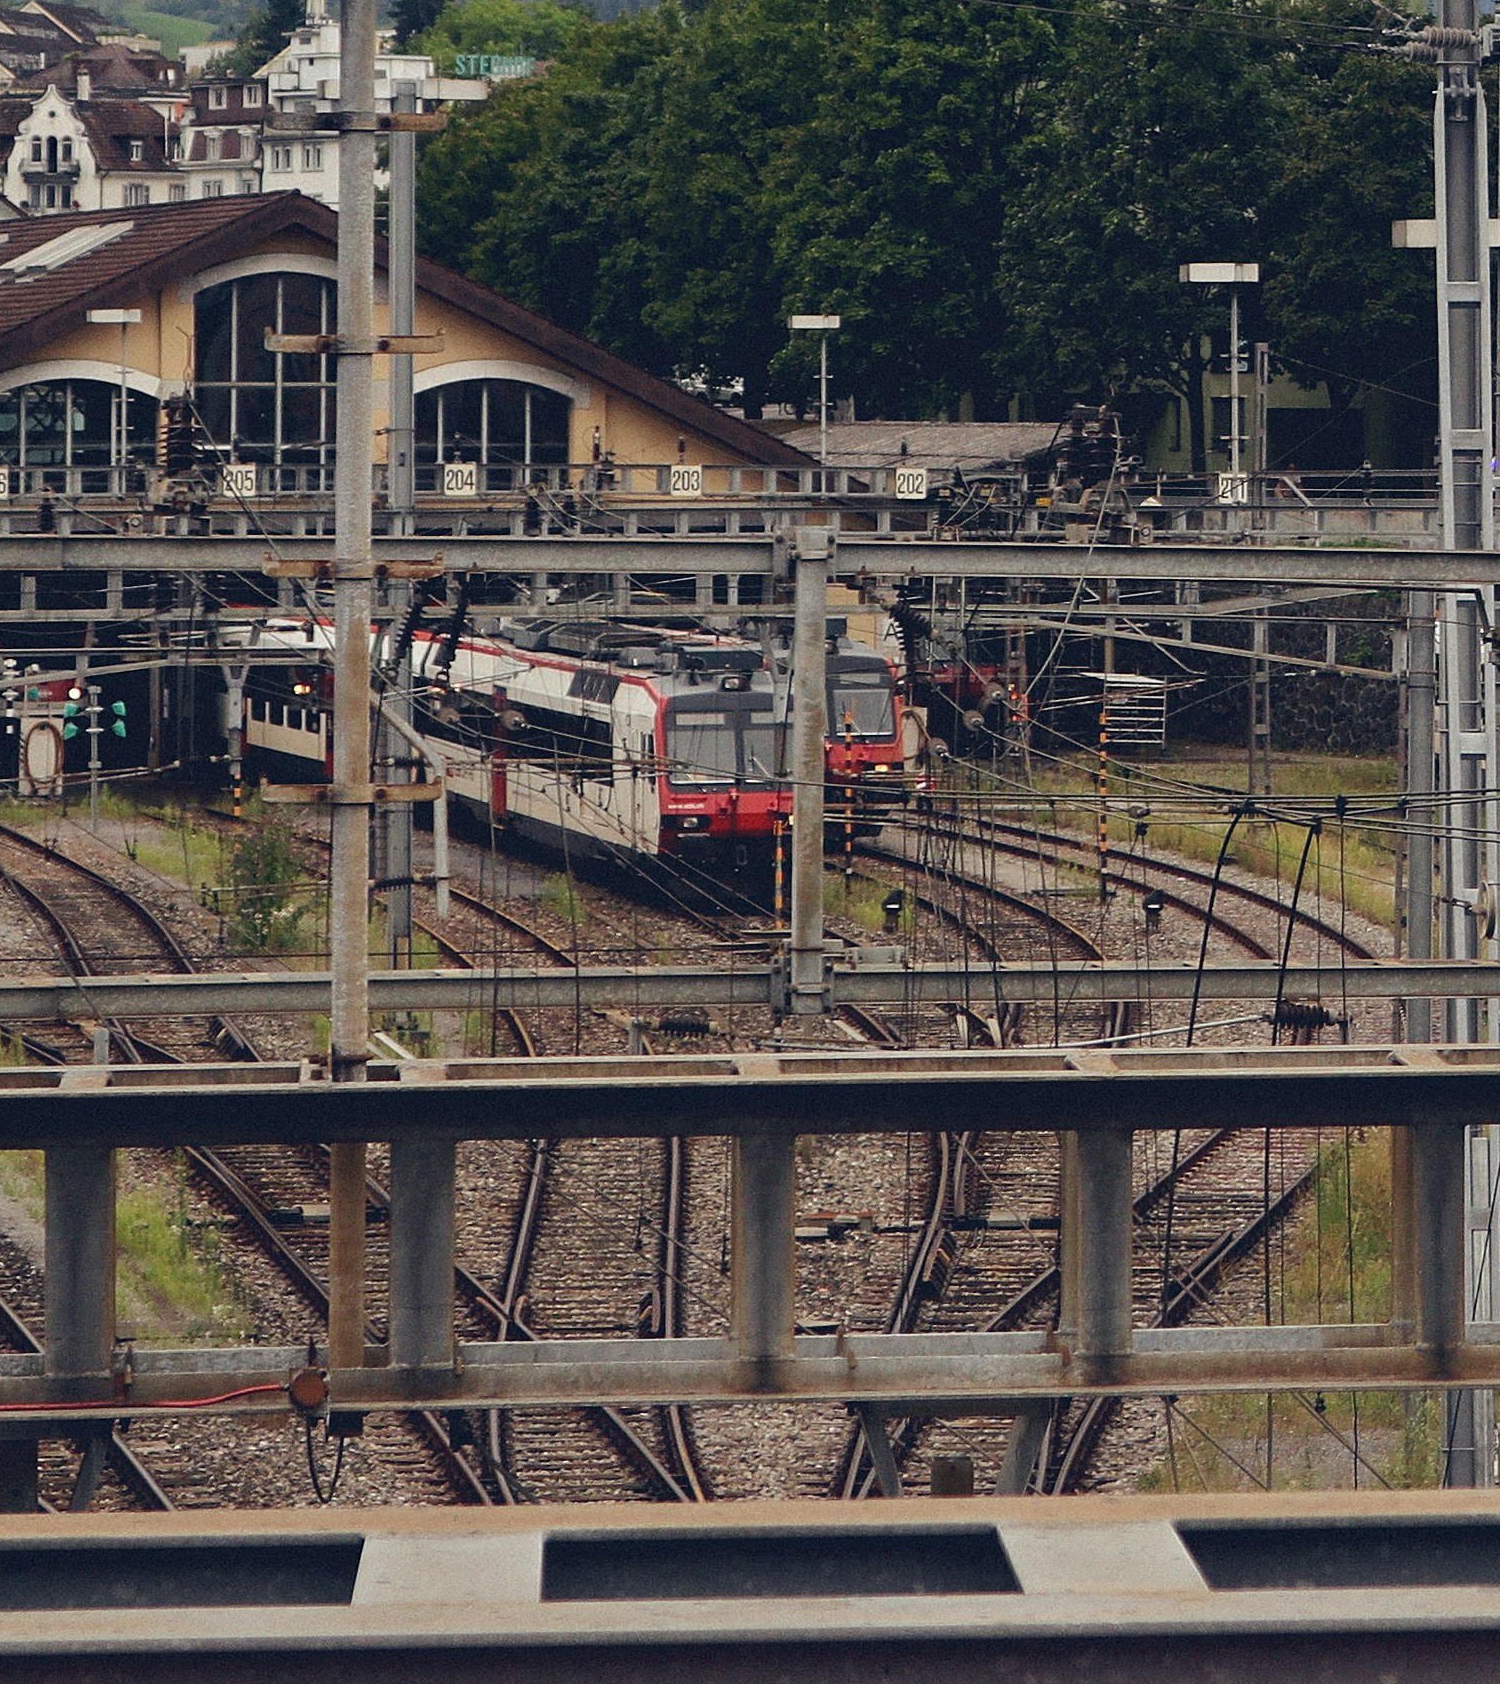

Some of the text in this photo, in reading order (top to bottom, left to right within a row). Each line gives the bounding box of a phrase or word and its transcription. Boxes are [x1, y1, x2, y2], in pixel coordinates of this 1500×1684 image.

[225, 470, 254, 492] 205
[446, 469, 475, 491] 204
[672, 470, 700, 492] 203
[897, 473, 924, 494] 202
